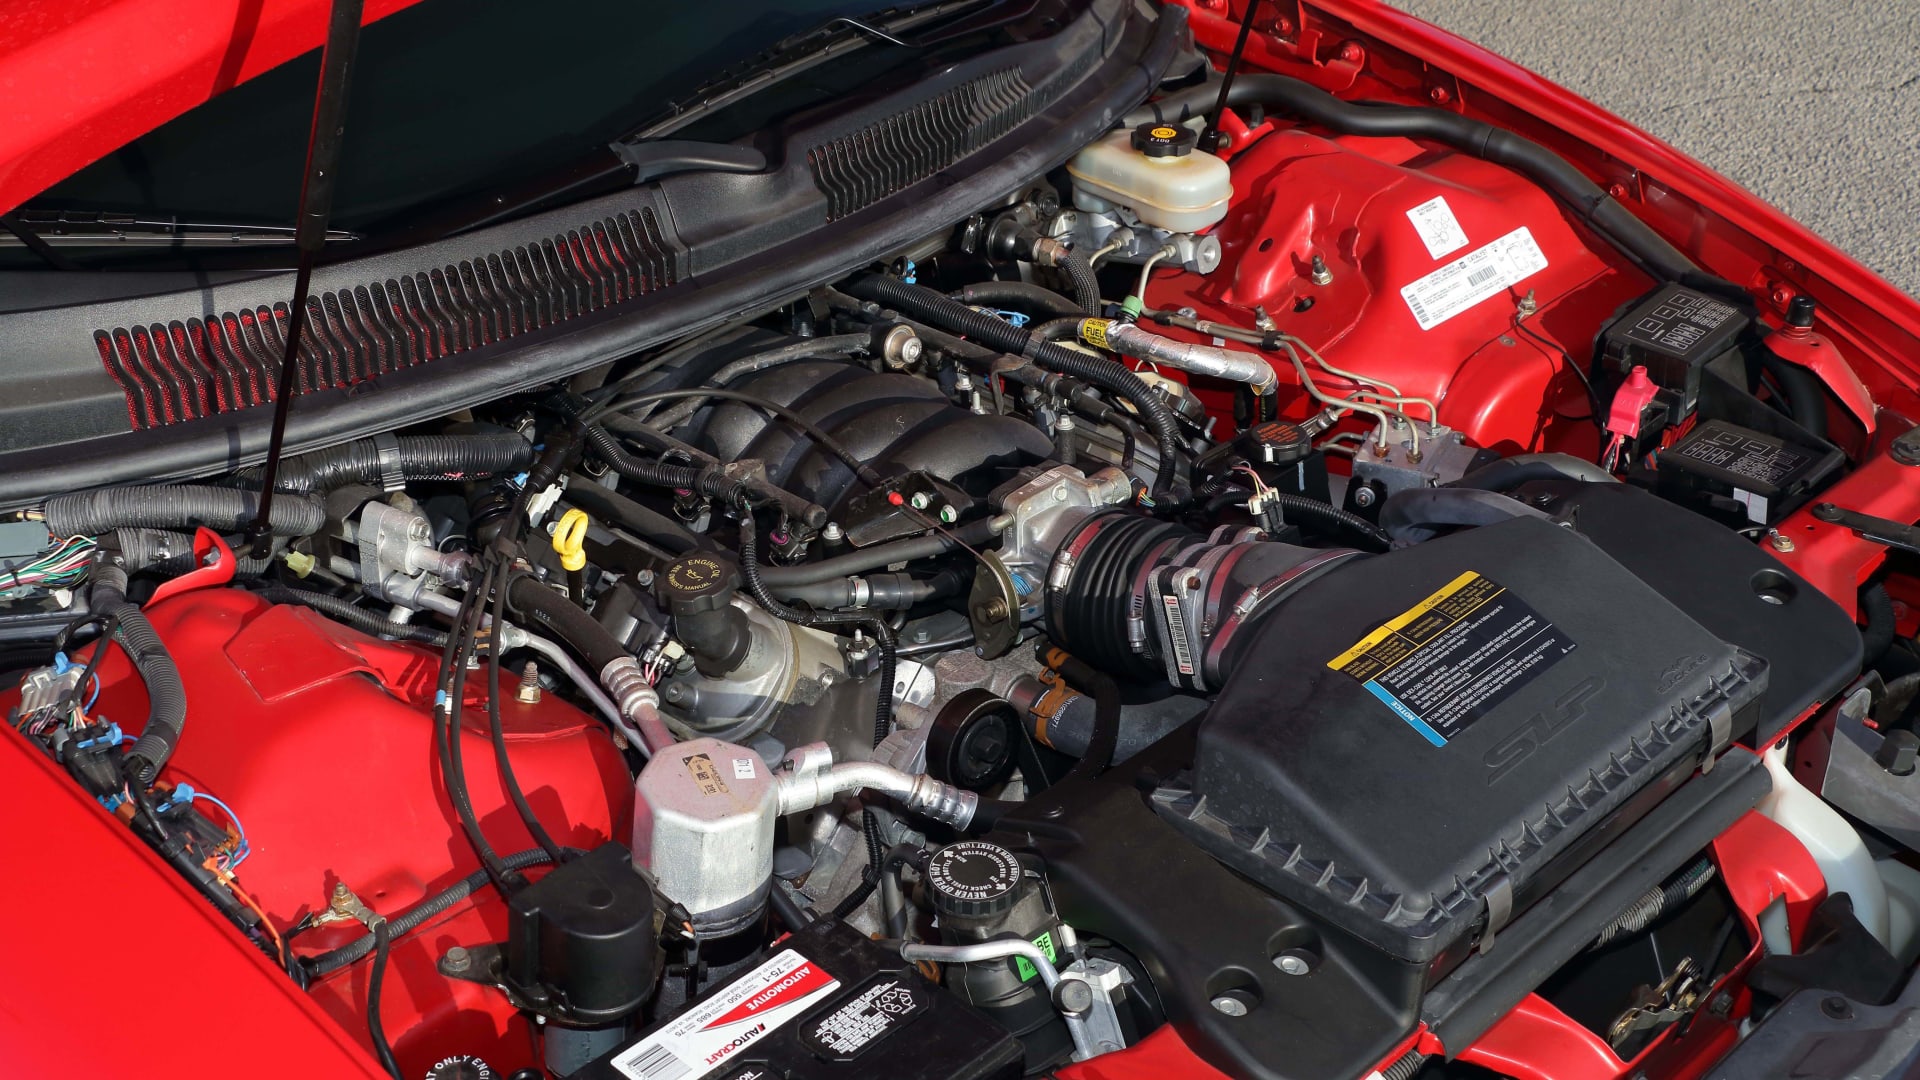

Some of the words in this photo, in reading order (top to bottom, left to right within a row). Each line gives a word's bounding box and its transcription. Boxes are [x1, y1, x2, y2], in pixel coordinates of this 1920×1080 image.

[1086, 326, 1102, 337] FUEL
[687, 559, 719, 569] ENGINE
[684, 581, 712, 591] MANUAL
[1391, 700, 1415, 721] NOTICE
[930, 862, 941, 876] HOT
[933, 876, 955, 893] OPEN
[954, 889, 987, 899] NEVER
[761, 966, 785, 982] 75-1
[746, 967, 810, 1011] AUTOMOTIVE
[726, 992, 742, 1004] 550
[695, 1011, 712, 1024] 685
[674, 1028, 686, 1037] 75
[703, 1026, 760, 1066] AUTOCRAFT
[434, 1054, 471, 1070] ONLY
